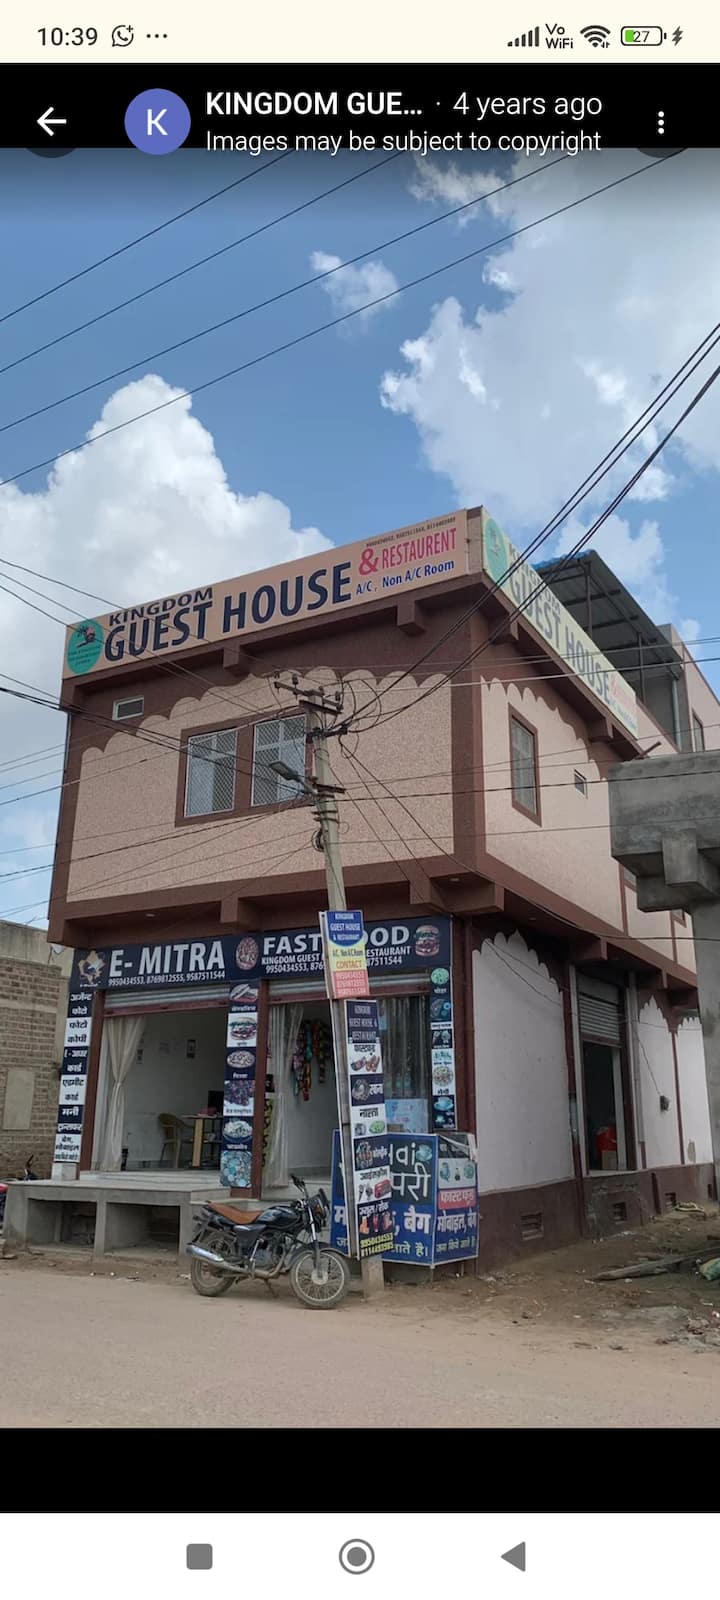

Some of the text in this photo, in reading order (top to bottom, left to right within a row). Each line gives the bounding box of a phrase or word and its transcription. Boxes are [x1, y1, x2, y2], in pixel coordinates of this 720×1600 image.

[358, 548, 379, 576] &
[382, 527, 457, 569] RESTAURENT
[382, 575, 402, 588] Non
[405, 568, 422, 582] A/C
[424, 560, 454, 576] Room
[104, 561, 352, 662] GUEST HOUSE
[109, 587, 213, 627] KINGDOM
[510, 567, 611, 706] GUEST HOUSE
[264, 933, 322, 955] FAST
[363, 925, 410, 946] OD
[330, 923, 360, 931] GUEST HOUSE
[261, 954, 296, 965] KINGDOM
[297, 953, 320, 963] GUEST
[366, 946, 411, 957] ESTAURANT
[266, 962, 309, 974] 9950434553,
[336, 961, 361, 969] CONTACT
[186, 970, 225, 982] 9587511544
[69, 1020, 88, 1029] फोटो
[62, 1107, 79, 1116] मनी
[391, 1162, 431, 1202] परी
